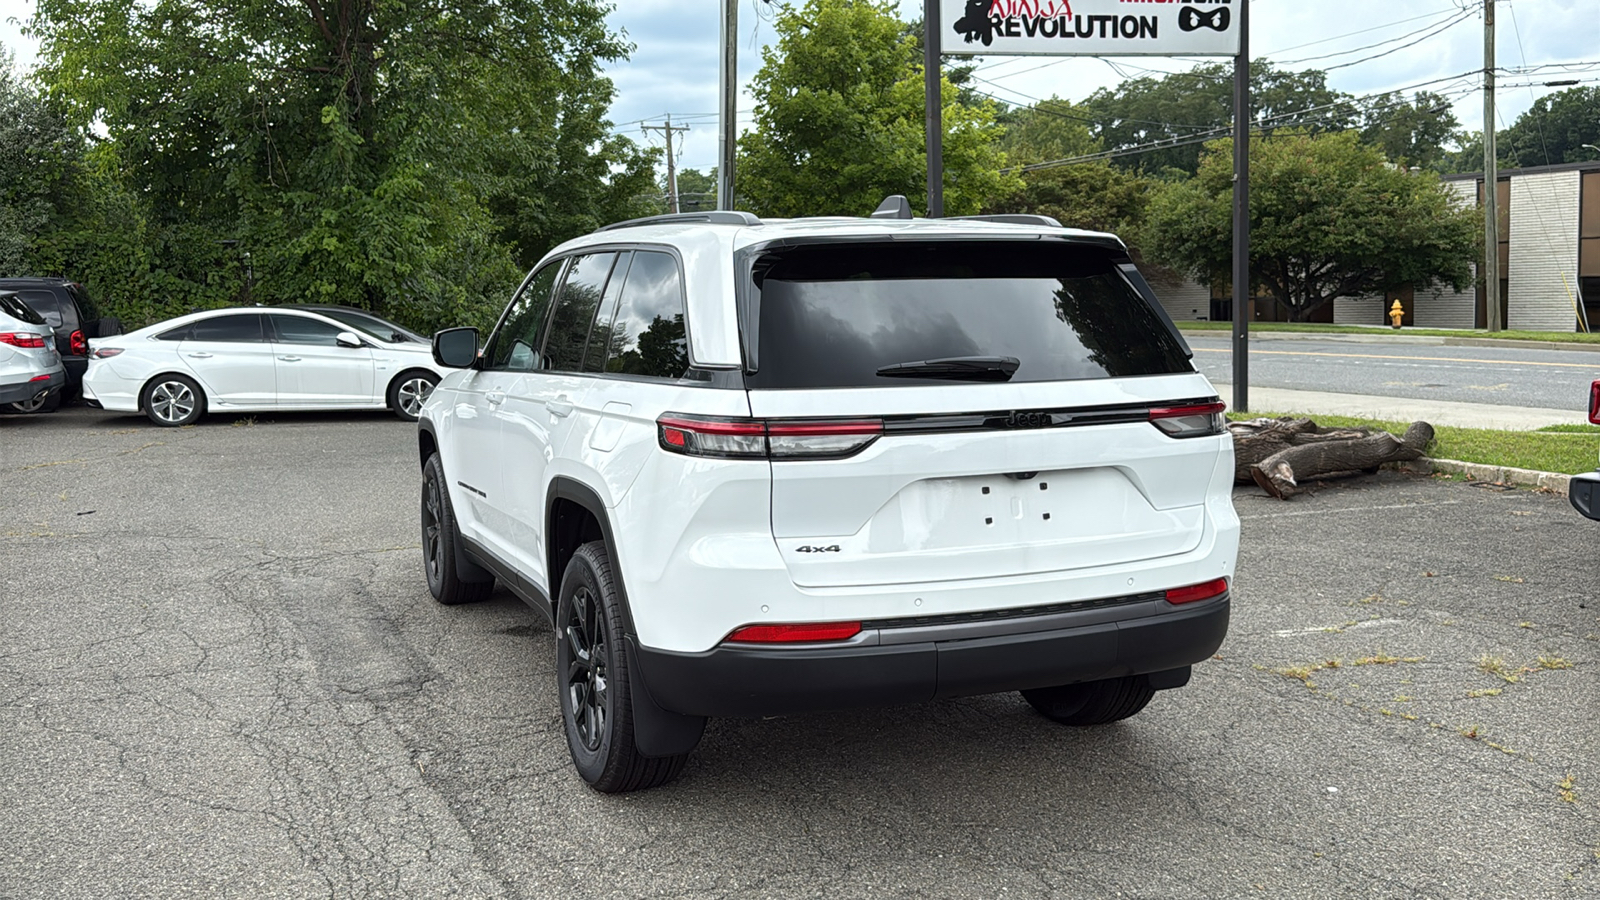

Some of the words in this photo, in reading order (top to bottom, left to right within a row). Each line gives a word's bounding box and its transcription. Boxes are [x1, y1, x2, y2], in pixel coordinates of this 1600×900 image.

[991, 13, 1157, 38] REVOLUTION
[1006, 410, 1049, 428] Jeep
[795, 545, 842, 553] 4x4
